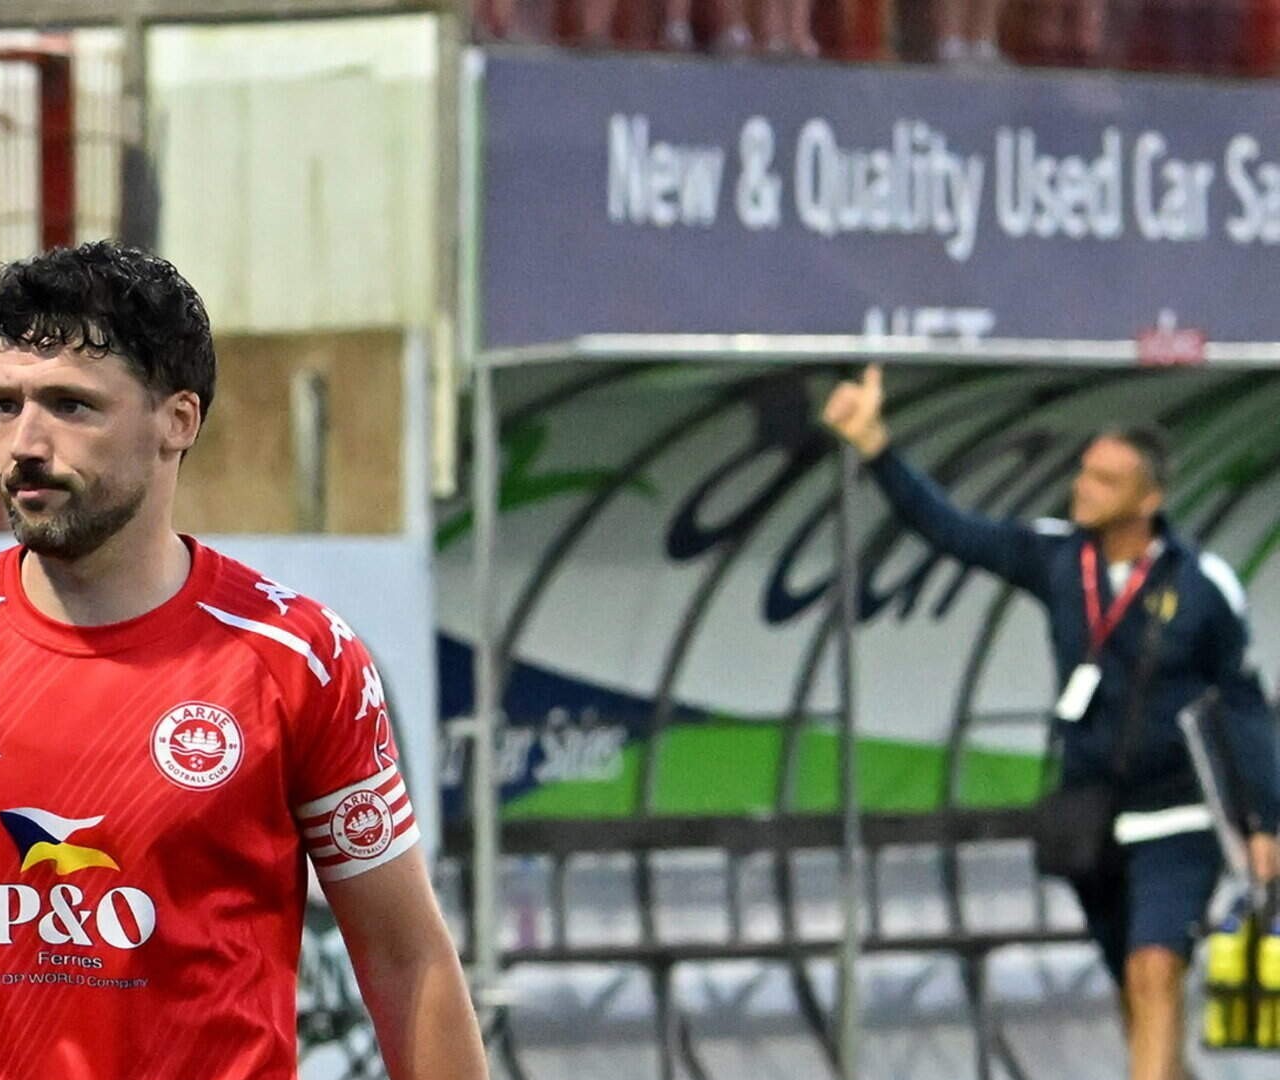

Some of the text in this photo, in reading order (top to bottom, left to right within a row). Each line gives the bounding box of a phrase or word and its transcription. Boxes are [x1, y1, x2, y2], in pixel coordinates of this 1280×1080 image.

[607, 112, 723, 226] New
[737, 114, 782, 231] &
[795, 117, 985, 263] Quality
[995, 125, 1124, 239] Used
[1132, 129, 1215, 241] Car
[170, 707, 230, 729] LARNE
[165, 759, 228, 783] FOOTBALL CLUB
[336, 793, 376, 818] LARNE
[37, 951, 103, 969] Ferries
[28, 971, 85, 986] WORLD
